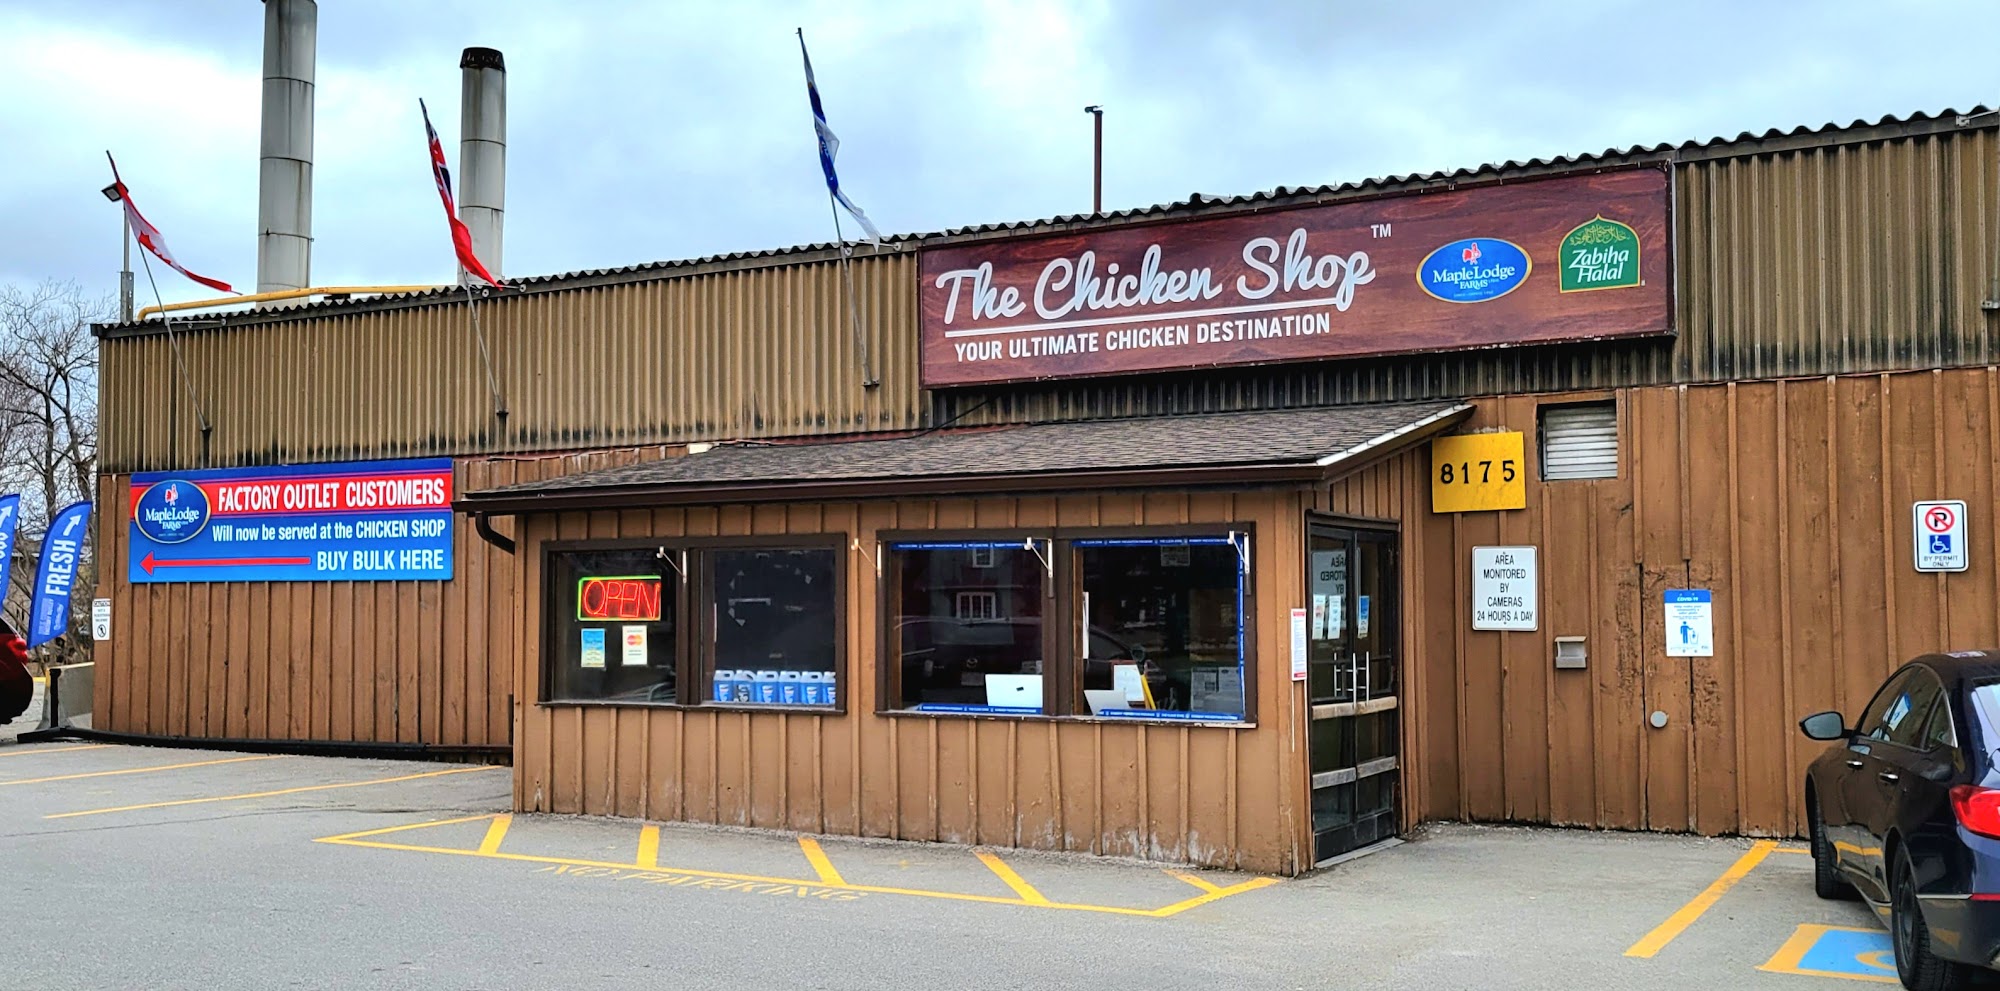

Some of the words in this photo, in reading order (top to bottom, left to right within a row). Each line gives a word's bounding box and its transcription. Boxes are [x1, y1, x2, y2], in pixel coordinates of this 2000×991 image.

[1568, 245, 1629, 269] Zabiha
[935, 261, 1027, 325] The
[1034, 244, 1222, 320] Chicken
[1236, 228, 1376, 312] Shop
[1577, 261, 1624, 283] Halal
[1460, 279, 1488, 290] FARMS
[954, 341, 1002, 362] YOUR
[1009, 333, 1099, 359] ULTIMATE
[1106, 324, 1189, 351] CHICKEN
[1197, 313, 1330, 344] DESTINATION
[1440, 460, 1516, 484] 8175
[218, 484, 280, 511] FACTORY
[283, 482, 340, 509] OUTLET
[345, 478, 445, 507] CUSTOMERS
[212, 525, 233, 542] Will
[235, 527, 259, 541] now
[262, 524, 275, 540] be
[278, 522, 317, 540] served
[320, 524, 331, 539] at
[334, 521, 353, 539] the
[356, 520, 408, 539] CHICKEN
[411, 519, 446, 537] SHOP
[45, 539, 76, 596] FRESH
[317, 550, 348, 571] BUY
[353, 550, 395, 570] BULK
[400, 549, 444, 570] HERE
[1495, 554, 1514, 565] AREA
[1483, 569, 1526, 579] MONITORED
[583, 579, 661, 619] OPEN
[1500, 583, 1509, 593] BY
[1487, 596, 1523, 607] CAMERAS
[1477, 611, 1485, 621] 24
[1488, 611, 1511, 621] HOURS
[1514, 611, 1519, 621] A
[1521, 611, 1533, 621] DAY
[616, 871, 869, 899] PARKING
